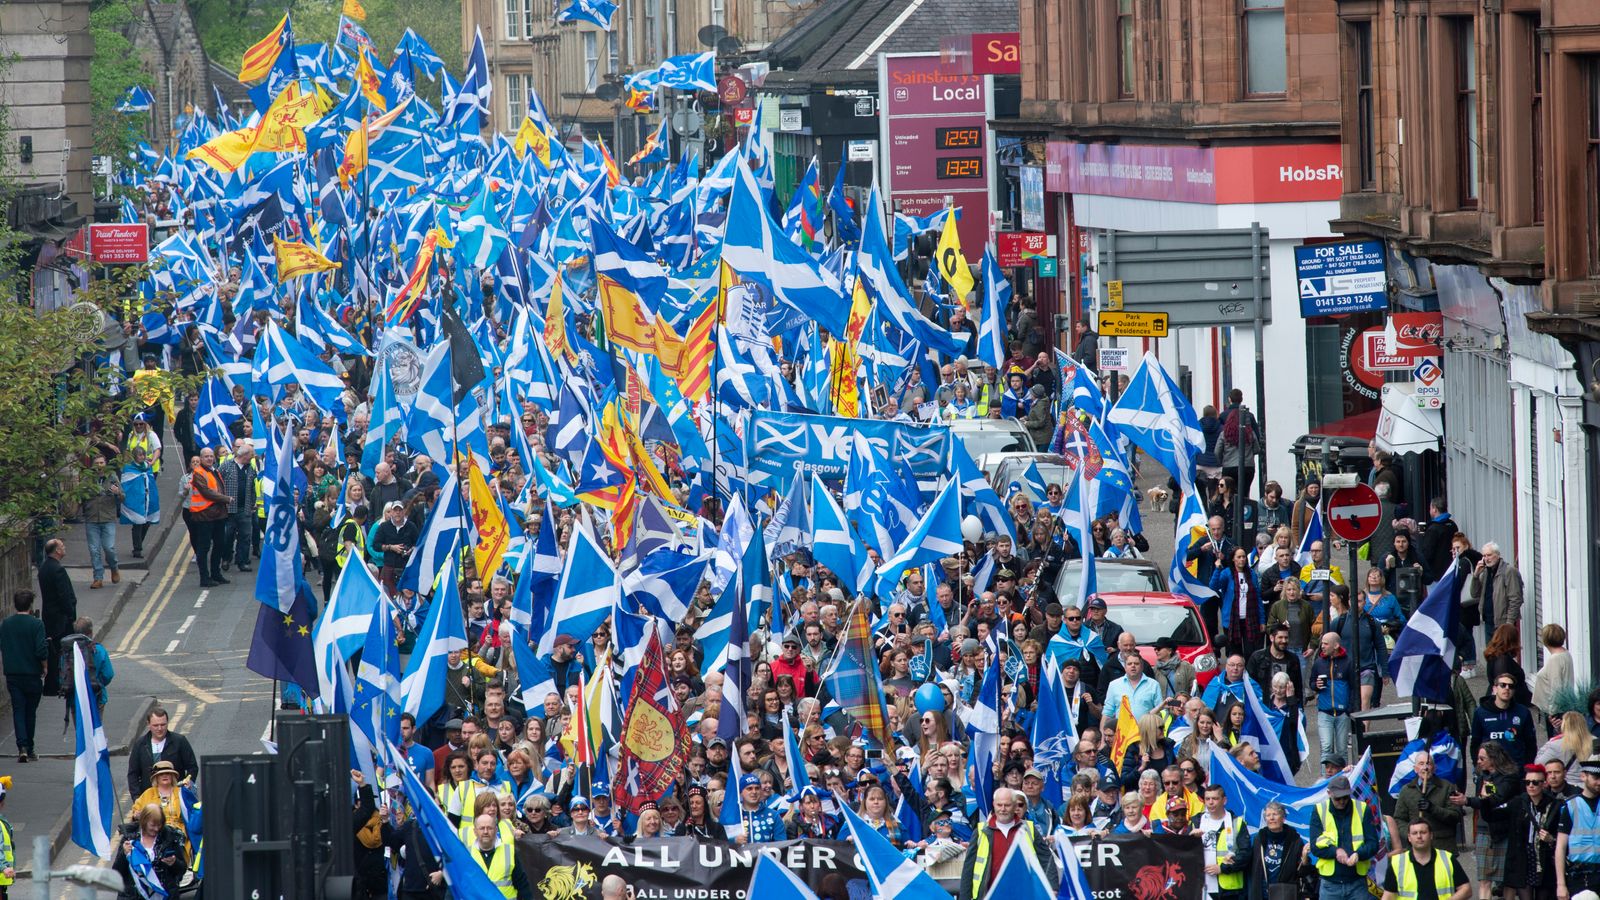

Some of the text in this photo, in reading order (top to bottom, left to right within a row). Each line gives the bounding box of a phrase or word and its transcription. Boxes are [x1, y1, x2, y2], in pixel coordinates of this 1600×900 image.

[987, 40, 1018, 62] Sa
[892, 70, 980, 85] Sainsburys
[932, 84, 980, 100] Local
[1026, 236, 1044, 244] JUST
[1315, 244, 1363, 257] FOR SALE
[1337, 297, 1352, 305] 530
[1340, 327, 1356, 368] PRINTED
[1343, 369, 1378, 400] FOLDERS
[1418, 388, 1439, 396] epay
[793, 460, 841, 474] Glasgow
[247, 774, 256, 784] 4
[250, 834, 258, 843] 5
[601, 846, 681, 867] ALL
[251, 889, 260, 900] 6
[636, 889, 668, 899] ALL
[674, 889, 730, 899] UNDER
